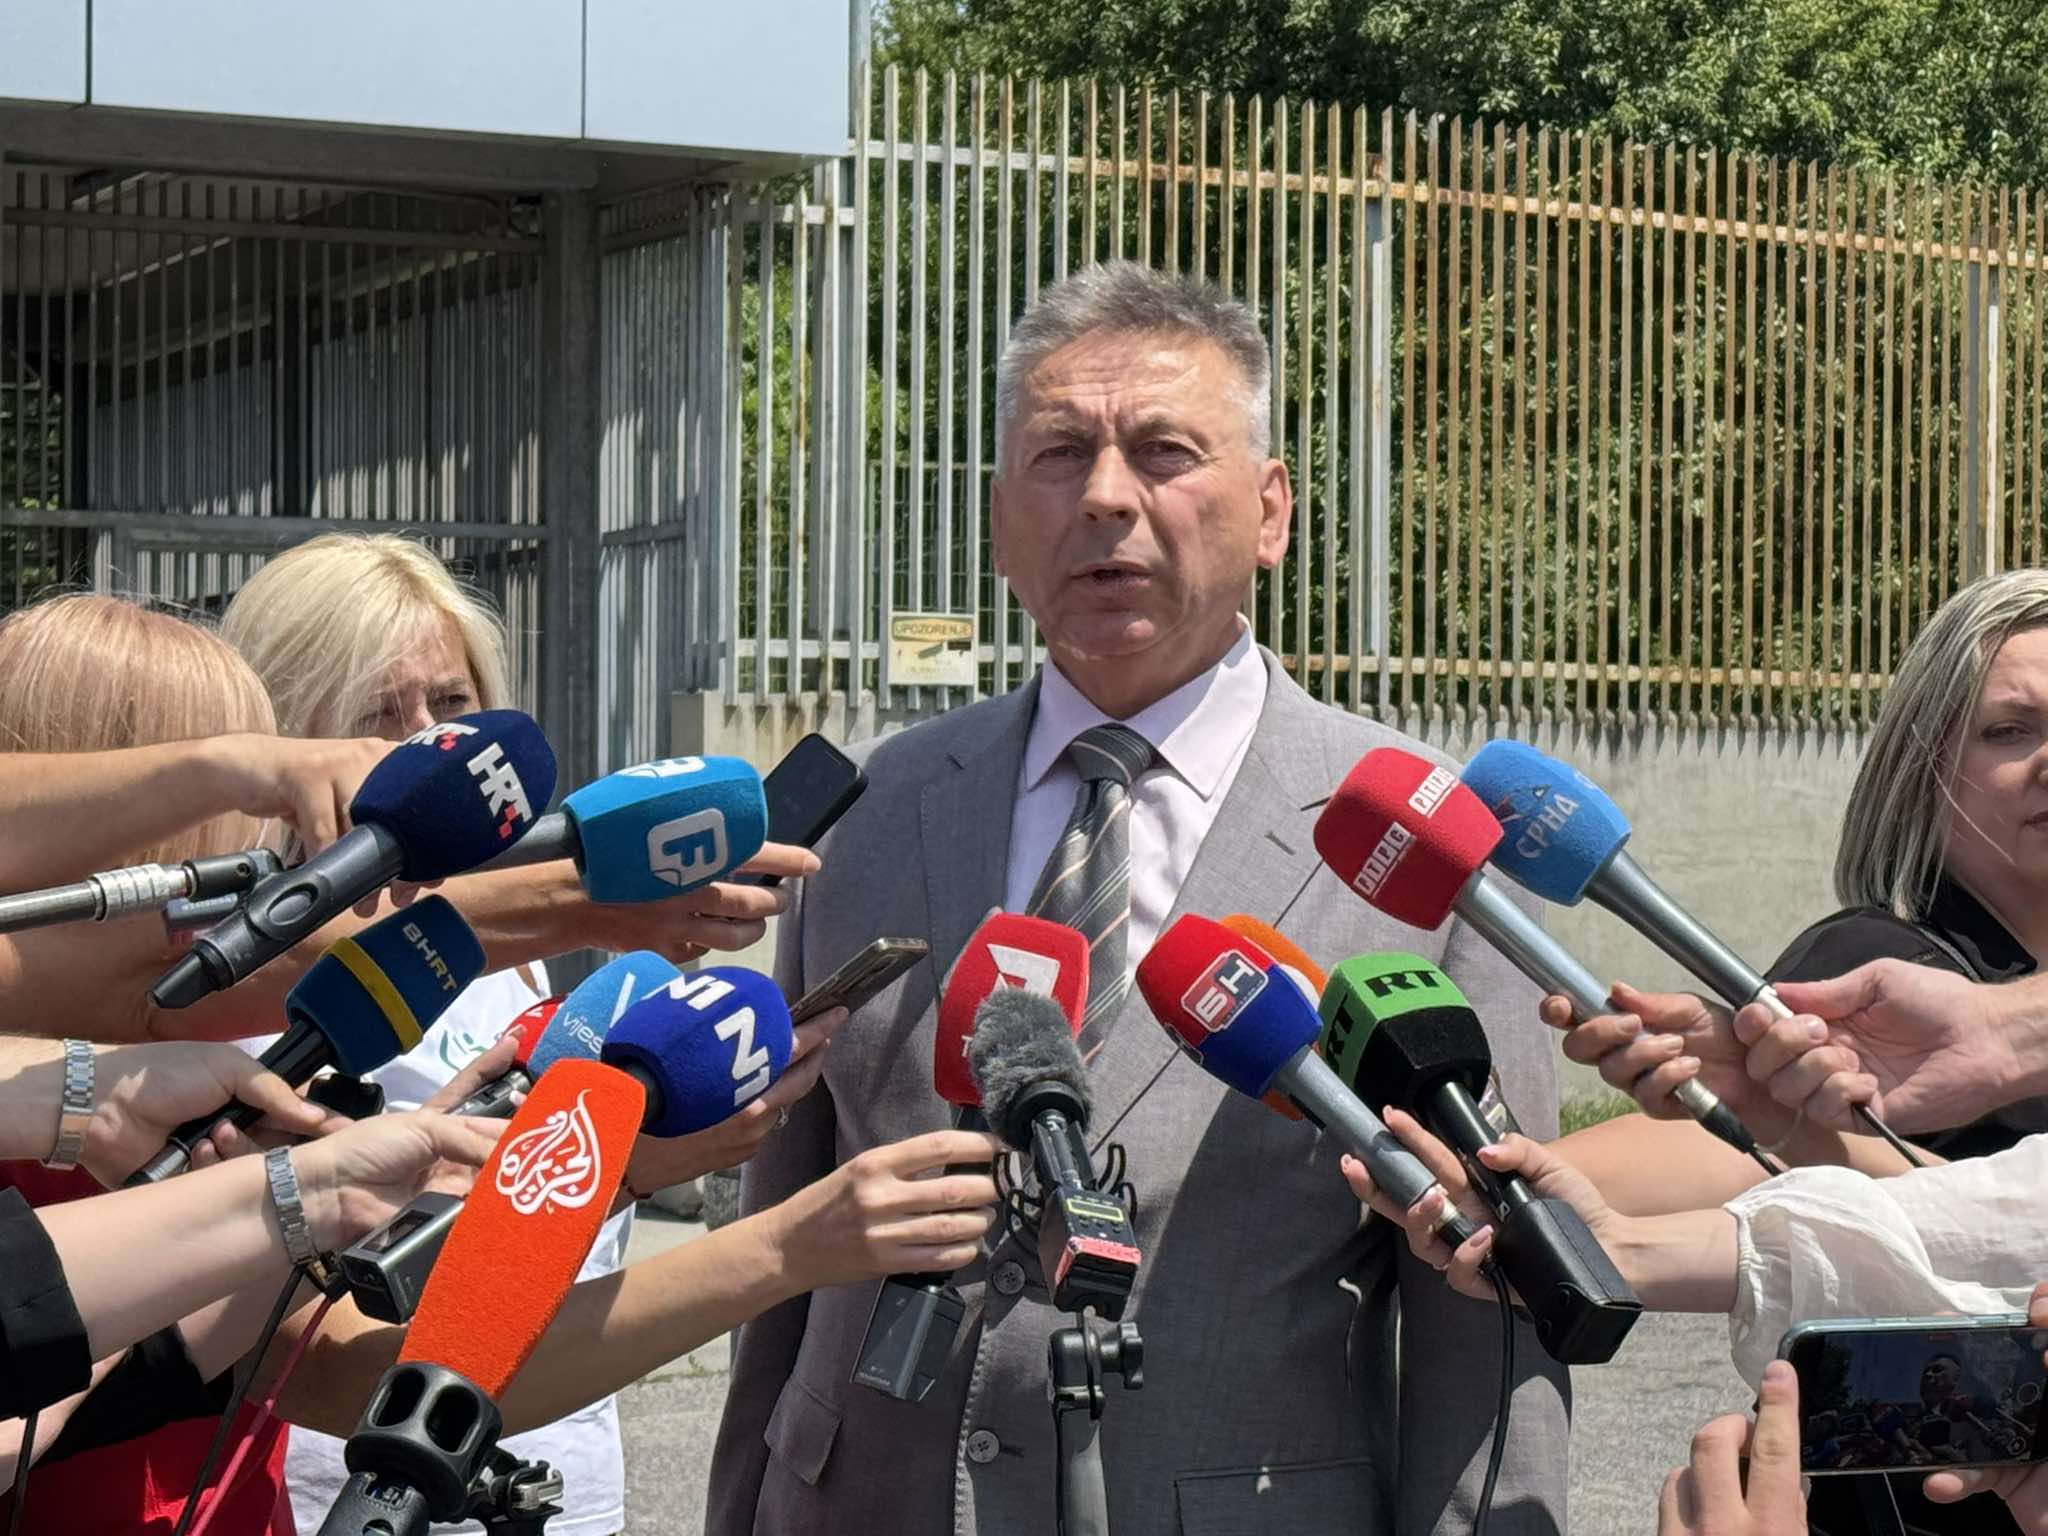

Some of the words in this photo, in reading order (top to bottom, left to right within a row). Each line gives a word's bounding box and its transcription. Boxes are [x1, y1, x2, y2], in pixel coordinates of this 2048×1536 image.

[467, 741, 533, 823] HRT
[402, 922, 458, 991] BHRT
[1364, 970, 1439, 998] RT
[563, 1012, 604, 1055] vijes
